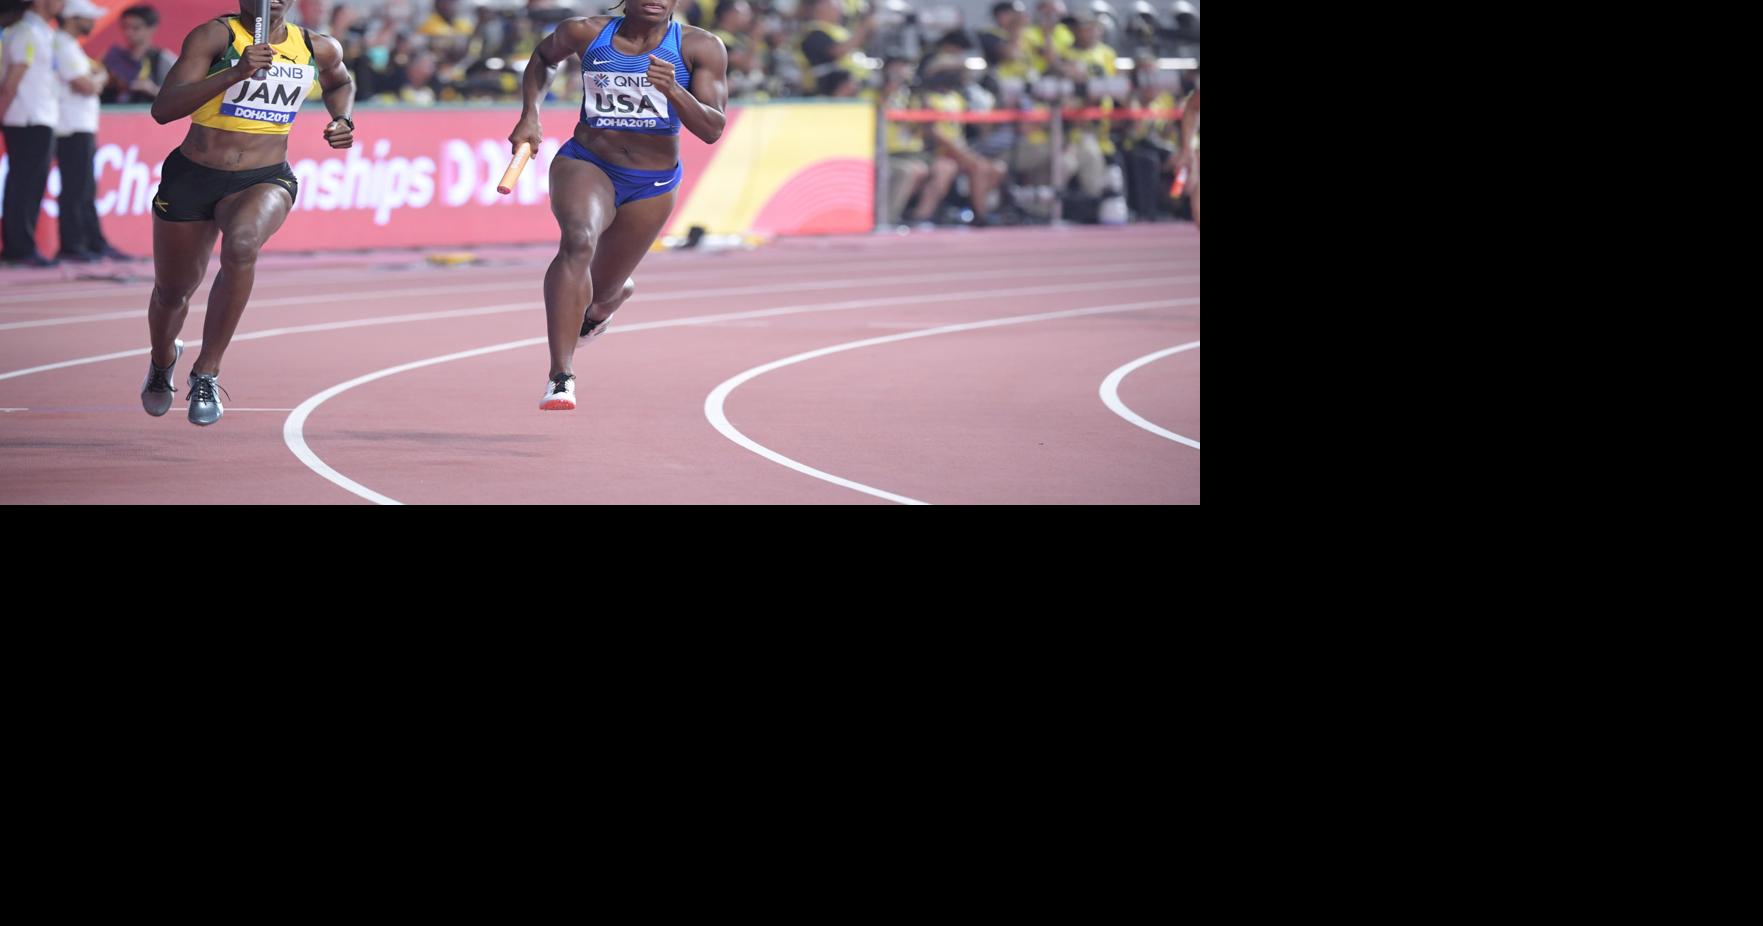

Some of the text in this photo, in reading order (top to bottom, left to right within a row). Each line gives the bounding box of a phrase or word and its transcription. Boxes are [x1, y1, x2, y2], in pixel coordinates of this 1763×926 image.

[267, 65, 304, 80] QNB
[613, 75, 654, 88] QNB
[231, 80, 302, 107] JAM
[595, 92, 660, 114] USA
[596, 117, 657, 128] DOHA2019
